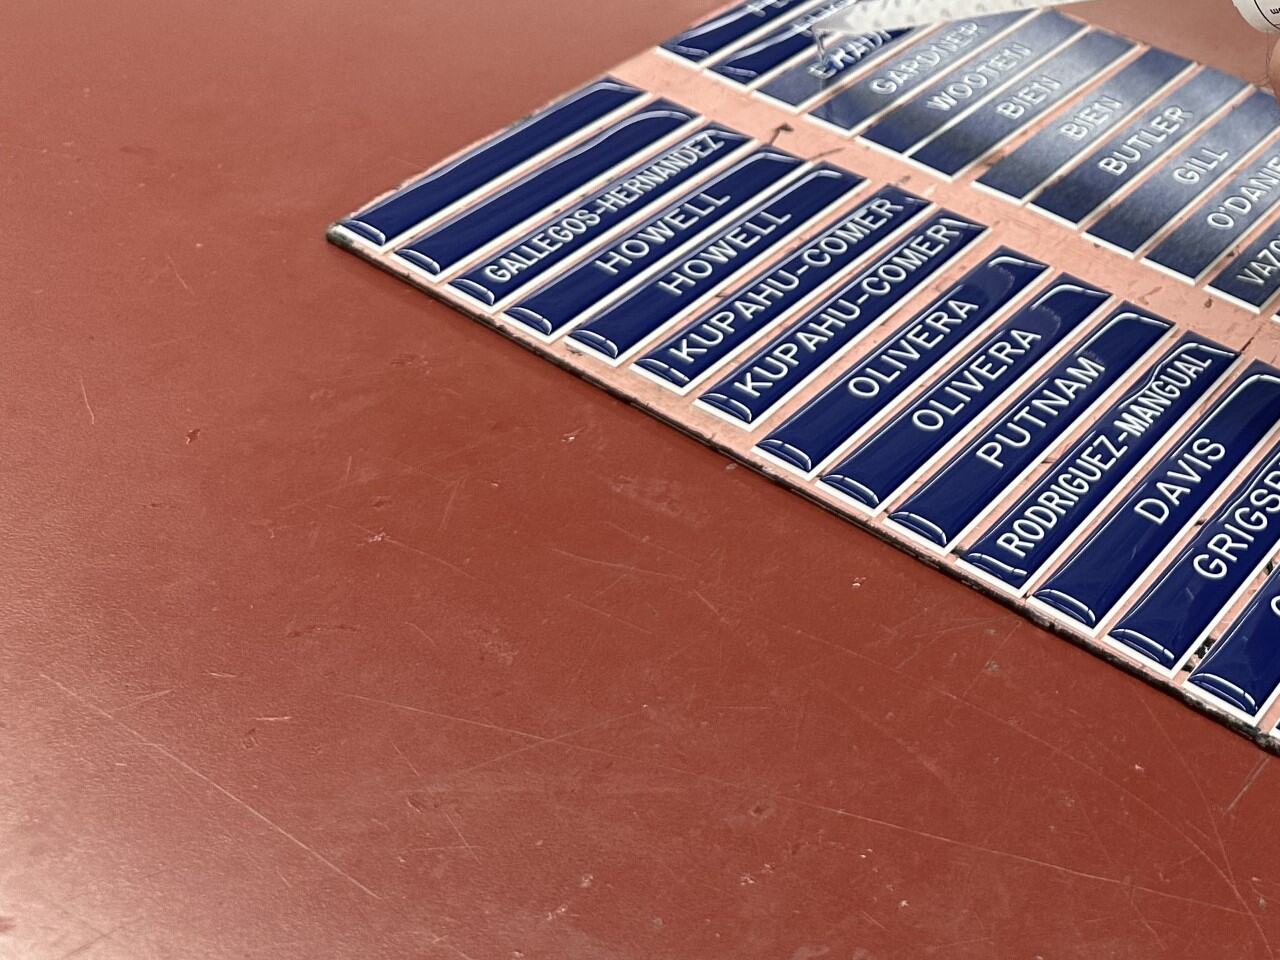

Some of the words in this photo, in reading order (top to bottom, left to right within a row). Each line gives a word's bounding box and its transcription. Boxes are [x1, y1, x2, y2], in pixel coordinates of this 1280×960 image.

[927, 41, 1031, 113] WOOTEN
[997, 74, 1063, 119] BIEN
[1061, 94, 1124, 141] BIEN
[1098, 104, 1194, 176] BUTLER
[1173, 146, 1229, 185] GILL
[483, 131, 725, 283] GALLEGOS-HERNANDEZ
[594, 189, 730, 275] HOWELL
[658, 208, 792, 296] HOWELL
[670, 197, 904, 364] KUPAHU-COMER
[733, 219, 957, 398] KUPAHU-COMER
[847, 297, 979, 399] OLIVERA
[912, 325, 1042, 431] OLIVERA
[977, 355, 1106, 469] PUTNAM
[997, 352, 1212, 558] RODRIGUEZ-MANGUAL
[1134, 435, 1227, 527] DAVIS
